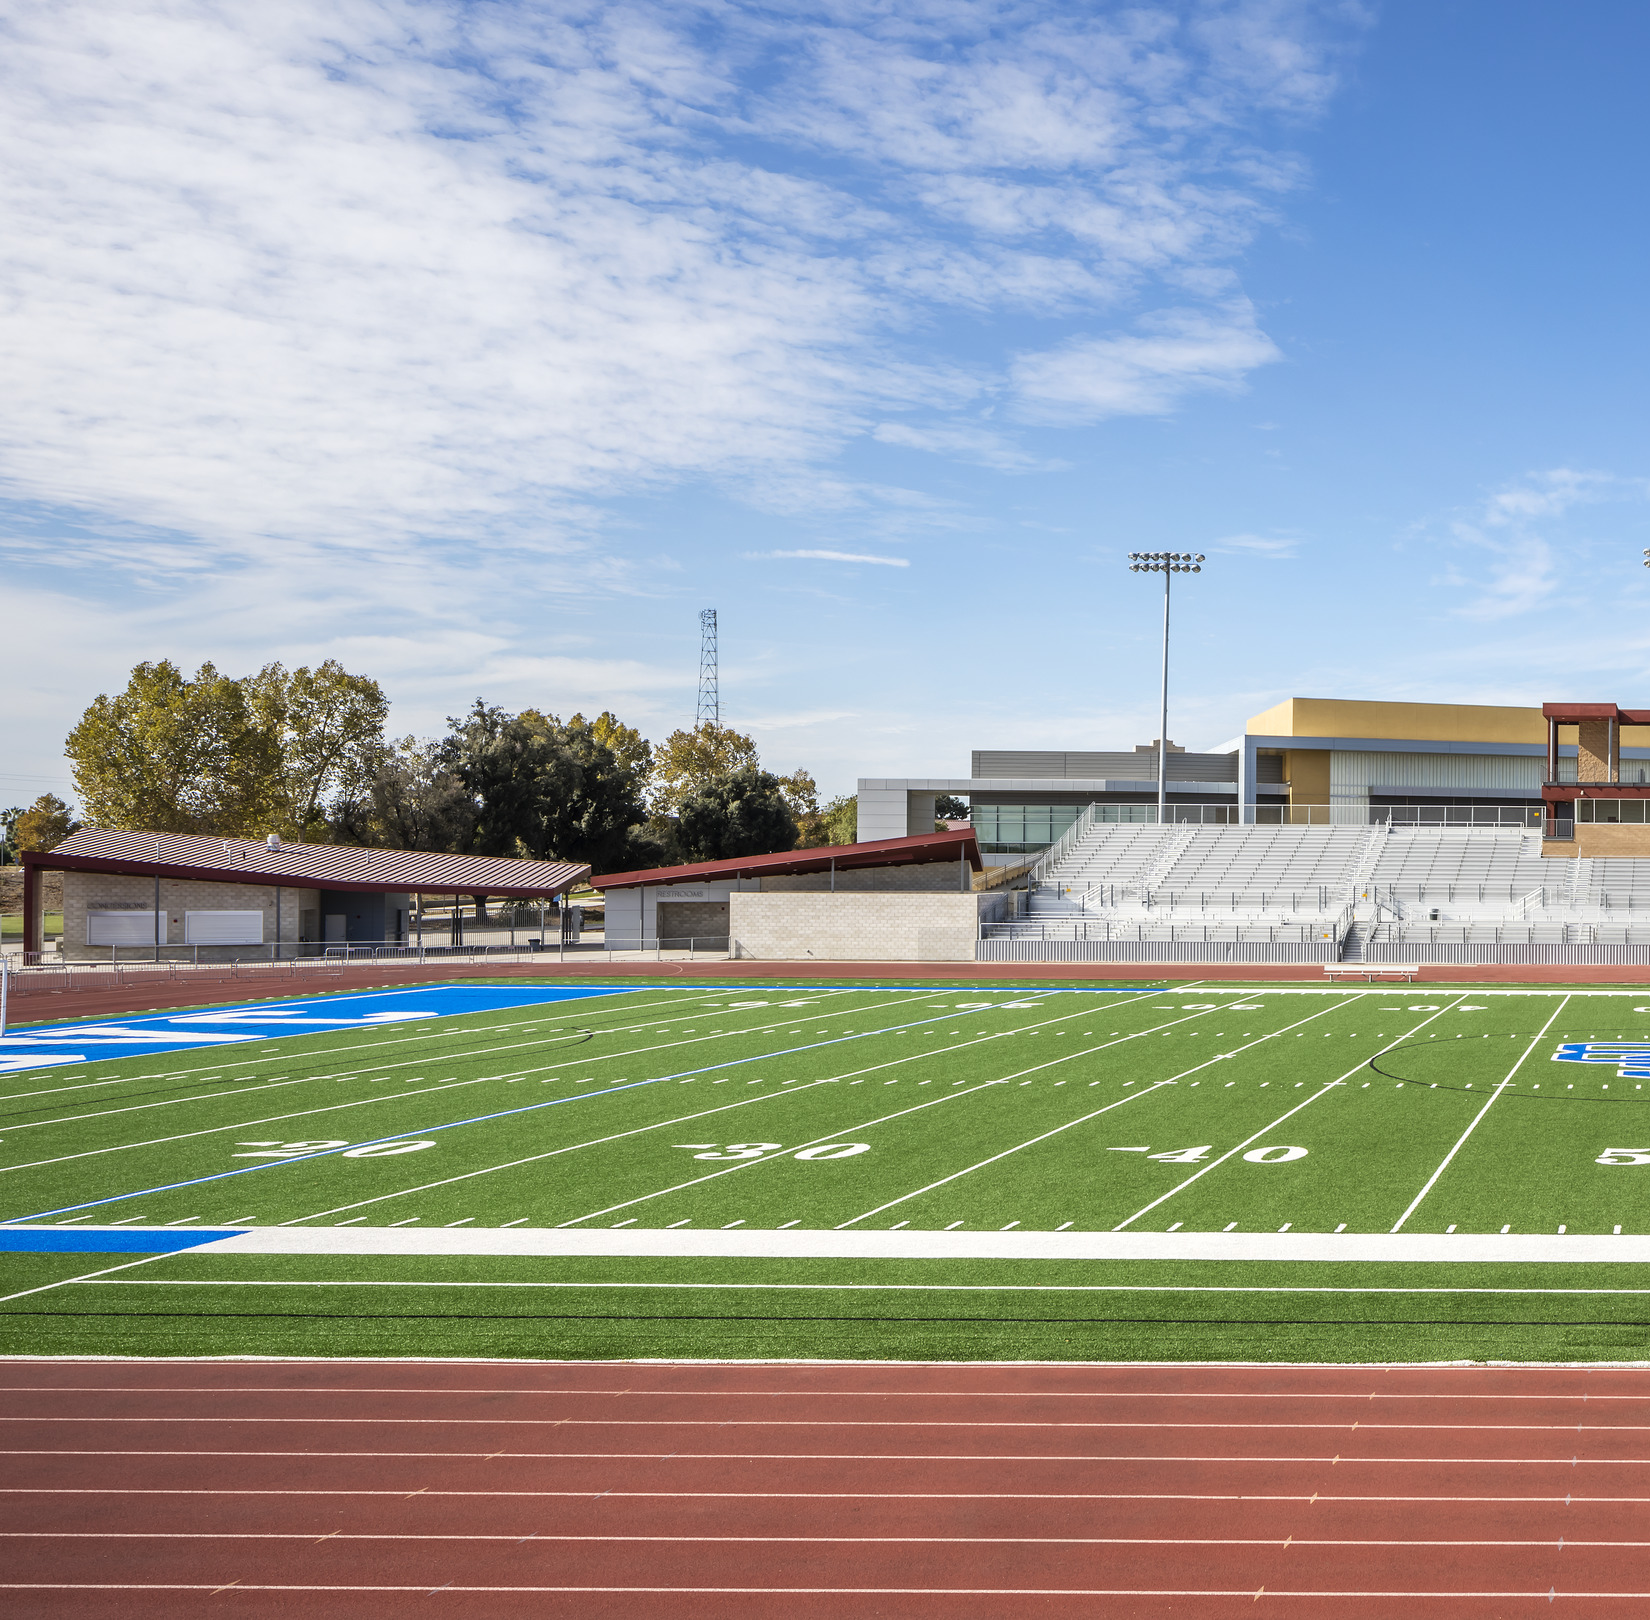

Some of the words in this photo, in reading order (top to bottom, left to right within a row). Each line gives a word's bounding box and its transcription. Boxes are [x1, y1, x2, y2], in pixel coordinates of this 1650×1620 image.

[657, 890, 704, 898] RESTROOMS
[87, 902, 148, 910] CONCESSIONS
[232, 1140, 437, 1158] 20
[693, 1143, 871, 1160] 30
[1147, 1145, 1309, 1163] 40
